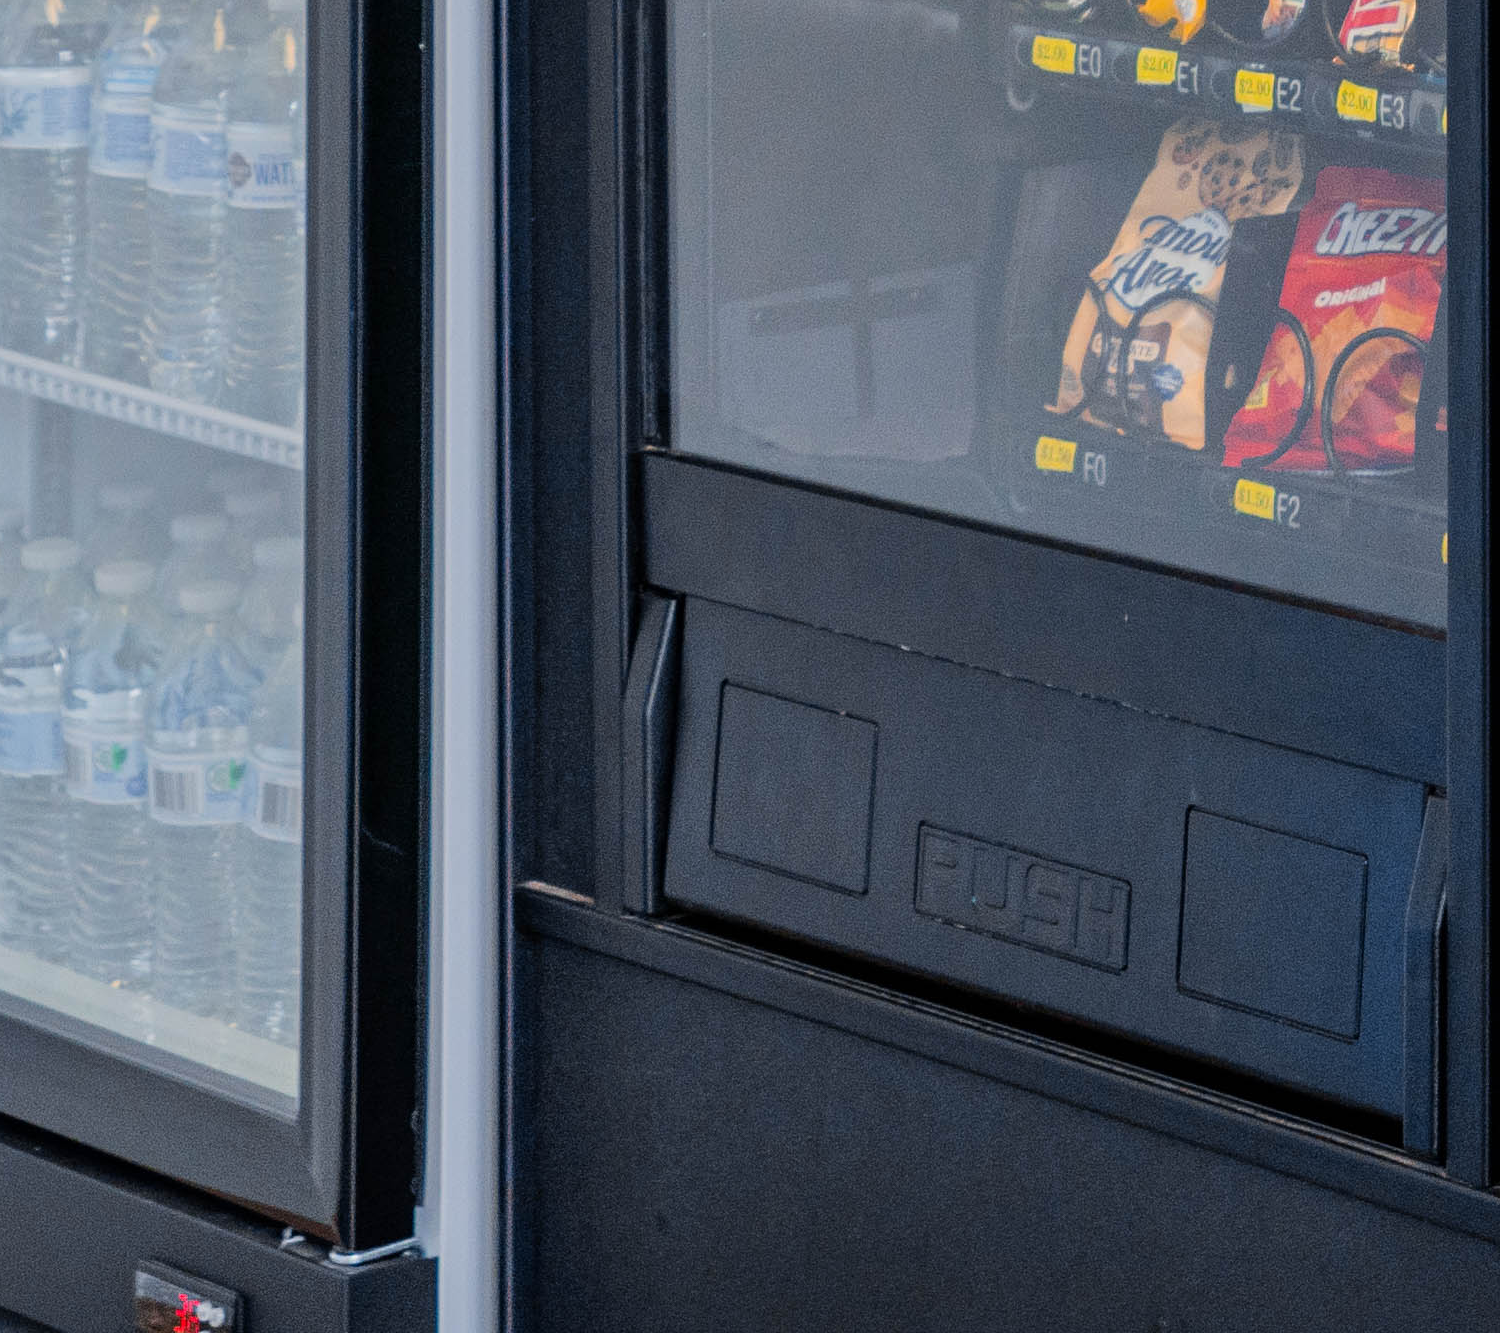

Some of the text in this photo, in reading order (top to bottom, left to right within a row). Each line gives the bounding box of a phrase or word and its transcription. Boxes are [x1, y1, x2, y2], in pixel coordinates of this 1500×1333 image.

[1036, 44, 1068, 64] $2.00
[1079, 44, 1102, 77] E0
[1141, 55, 1174, 75] $2.00
[1177, 60, 1199, 94] E1
[1239, 77, 1272, 98] $2.00
[1276, 77, 1301, 109] E2
[1340, 90, 1373, 112] $2.00
[1380, 94, 1404, 127] E3
[1083, 451, 1106, 485] F0
[1239, 487, 1270, 509] $1.50
[1276, 494, 1300, 527] F2
[924, 829, 1130, 963] PUSH
